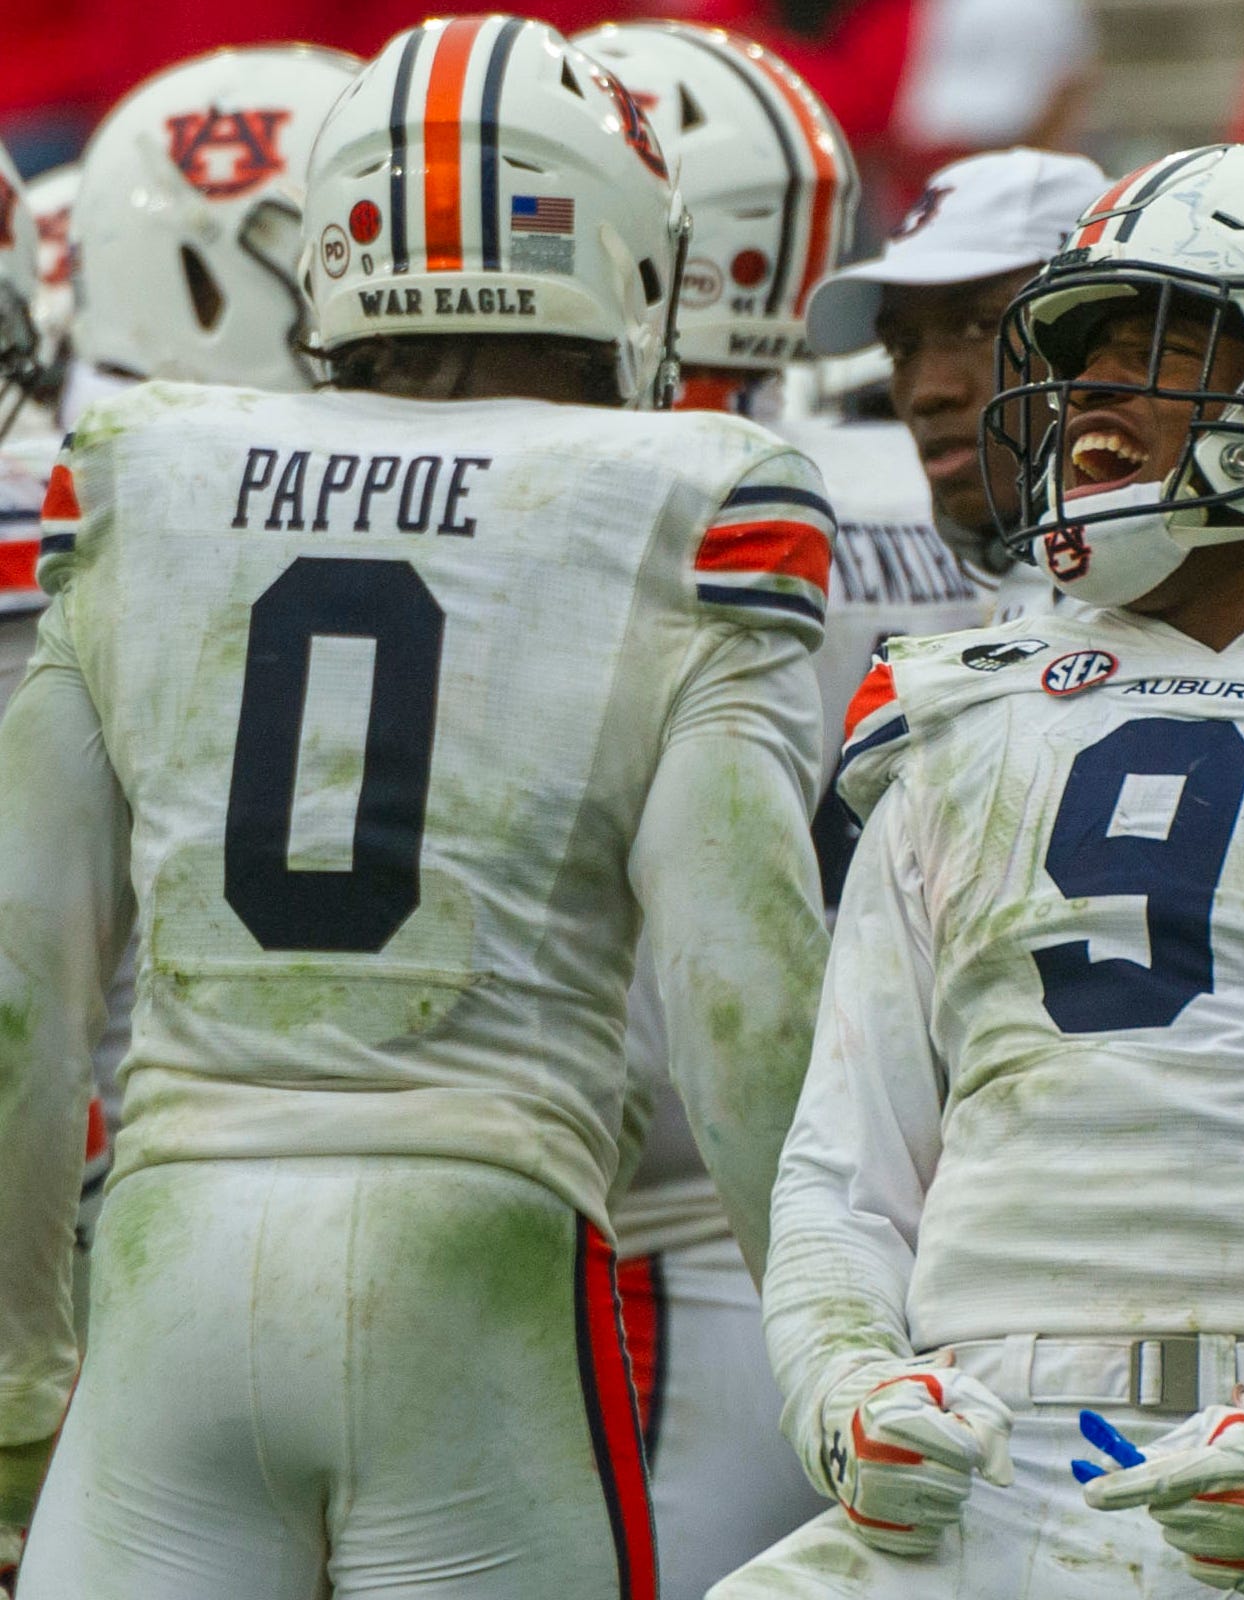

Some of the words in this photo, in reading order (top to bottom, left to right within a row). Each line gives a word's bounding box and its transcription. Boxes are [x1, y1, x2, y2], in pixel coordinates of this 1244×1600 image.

[325, 241, 344, 261] PD
[359, 288, 422, 317] WAR
[434, 288, 536, 315] EAGLE
[231, 447, 493, 538] PAPPOE
[1047, 652, 1111, 691] SEC
[224, 556, 446, 954] 0
